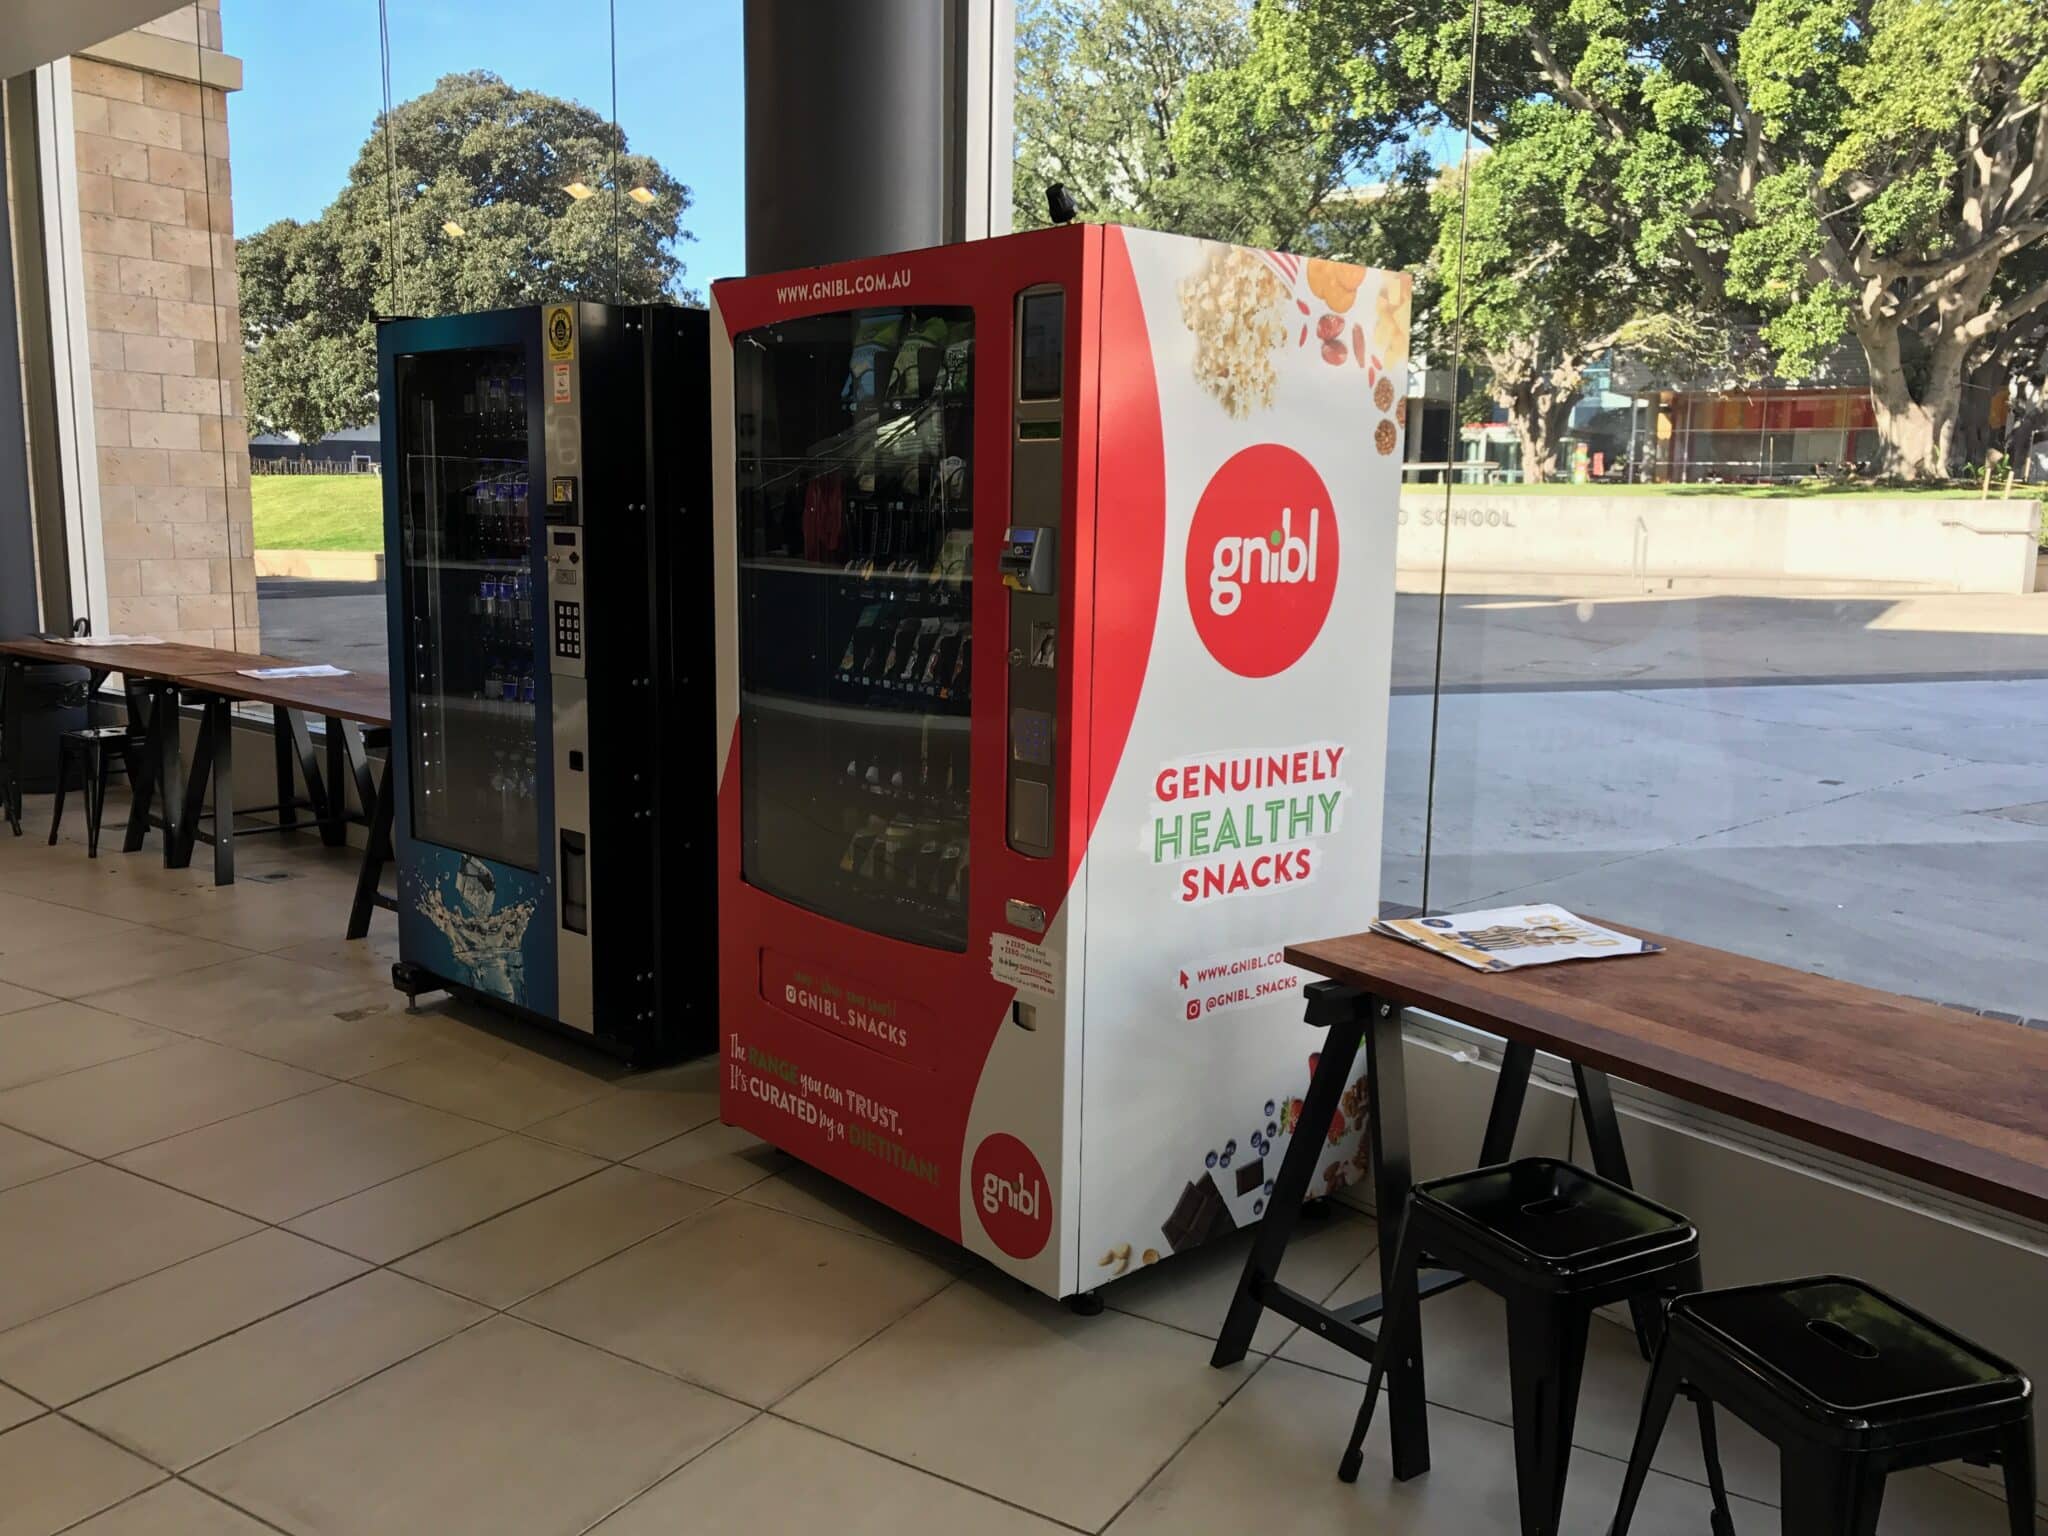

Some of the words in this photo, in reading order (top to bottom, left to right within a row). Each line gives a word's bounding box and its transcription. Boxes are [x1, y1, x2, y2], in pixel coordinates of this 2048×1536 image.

[776, 268, 911, 304] WWW.GNIBL.COM.AU
[1421, 507, 1517, 528] SCHOOL
[1209, 507, 1320, 617] gnibl
[1155, 746, 1345, 802] GENUINELY
[1154, 790, 1342, 863] HEALTHY
[1182, 848, 1311, 902] SNACKS
[1197, 951, 1284, 982] WWW.GNIBL.CO
[1206, 975, 1298, 1012] @GNIBL_SNACKS
[730, 1032, 746, 1062] The
[749, 1047, 799, 1085] RANGE
[800, 1073, 822, 1097] you
[823, 1083, 844, 1107] can
[846, 1089, 903, 1136] TRUST.
[730, 1064, 748, 1092] It's
[750, 1077, 818, 1124] CURATED
[819, 1108, 836, 1142] by
[836, 1121, 845, 1139] a
[982, 1171, 1040, 1221] gnibl
